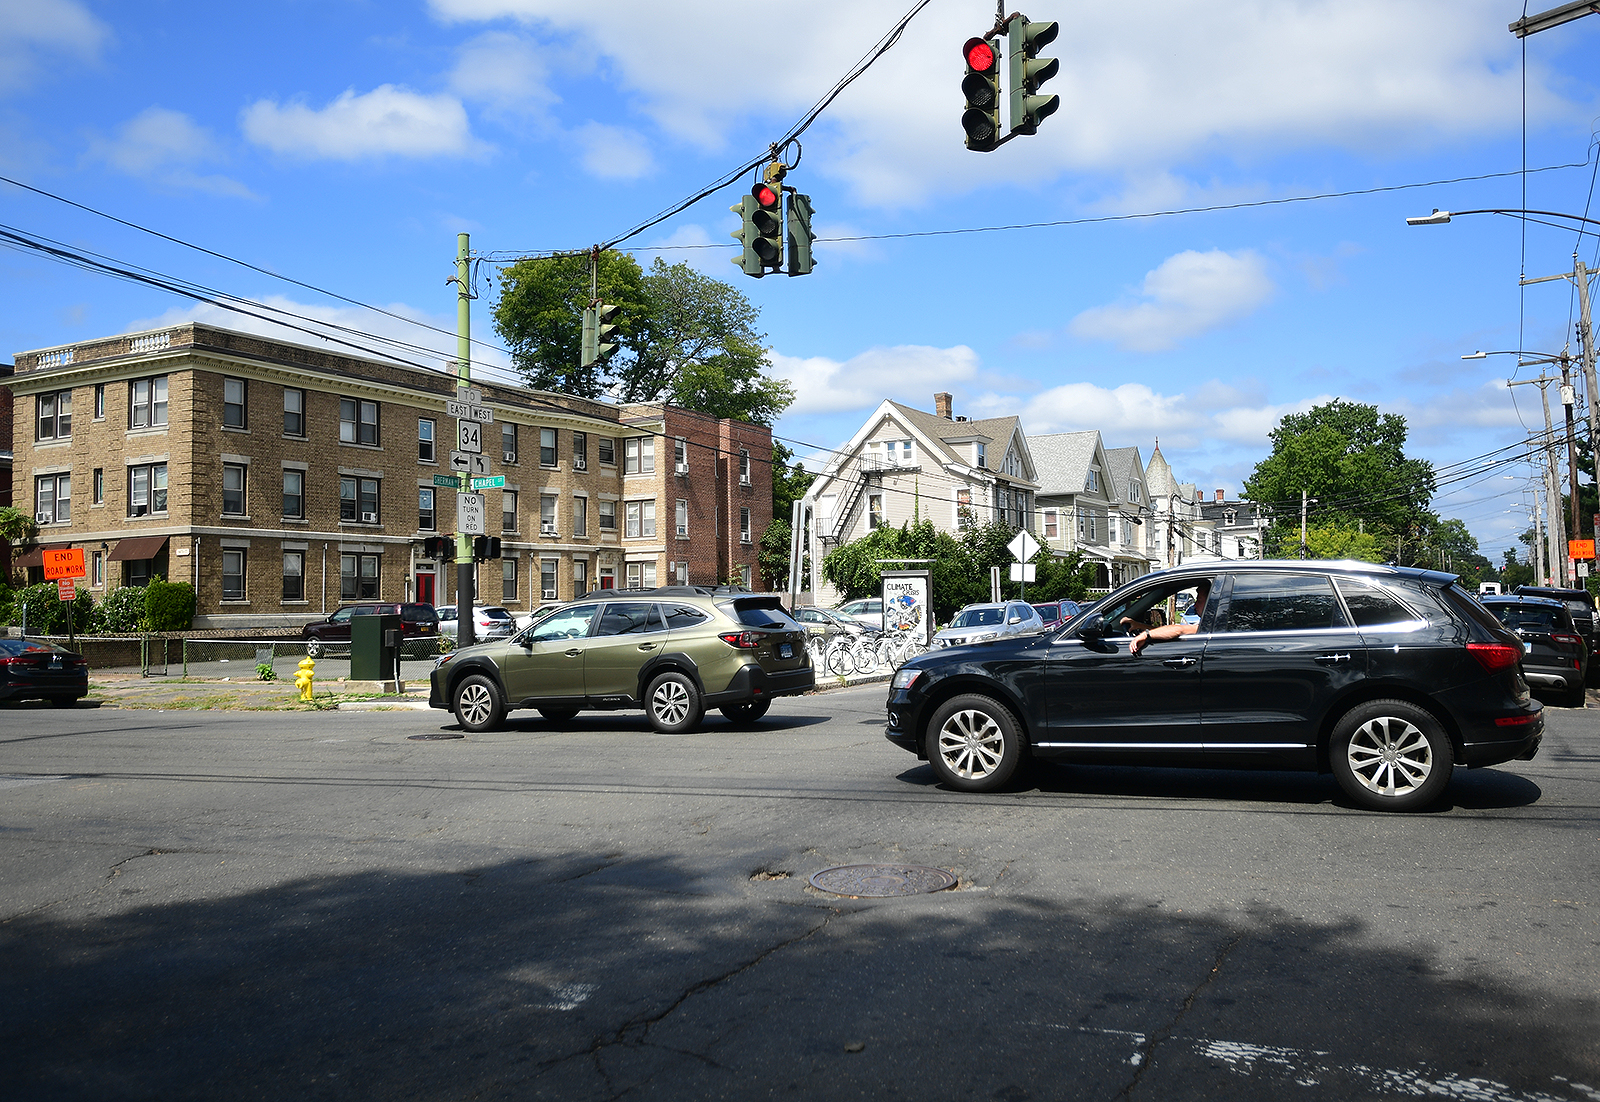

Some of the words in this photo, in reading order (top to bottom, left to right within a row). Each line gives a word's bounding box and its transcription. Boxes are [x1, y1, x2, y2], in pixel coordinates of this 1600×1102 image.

[464, 391, 475, 401] TO
[450, 404, 468, 415] EAST
[473, 409, 491, 420] WEST
[462, 427, 478, 446] 34
[434, 475, 454, 486] SHERMAN
[475, 478, 496, 488] CHAPEL
[464, 496, 476, 505] NO
[55, 553, 73, 561] END
[46, 566, 63, 575] ROAD
[66, 565, 83, 573] WORK
